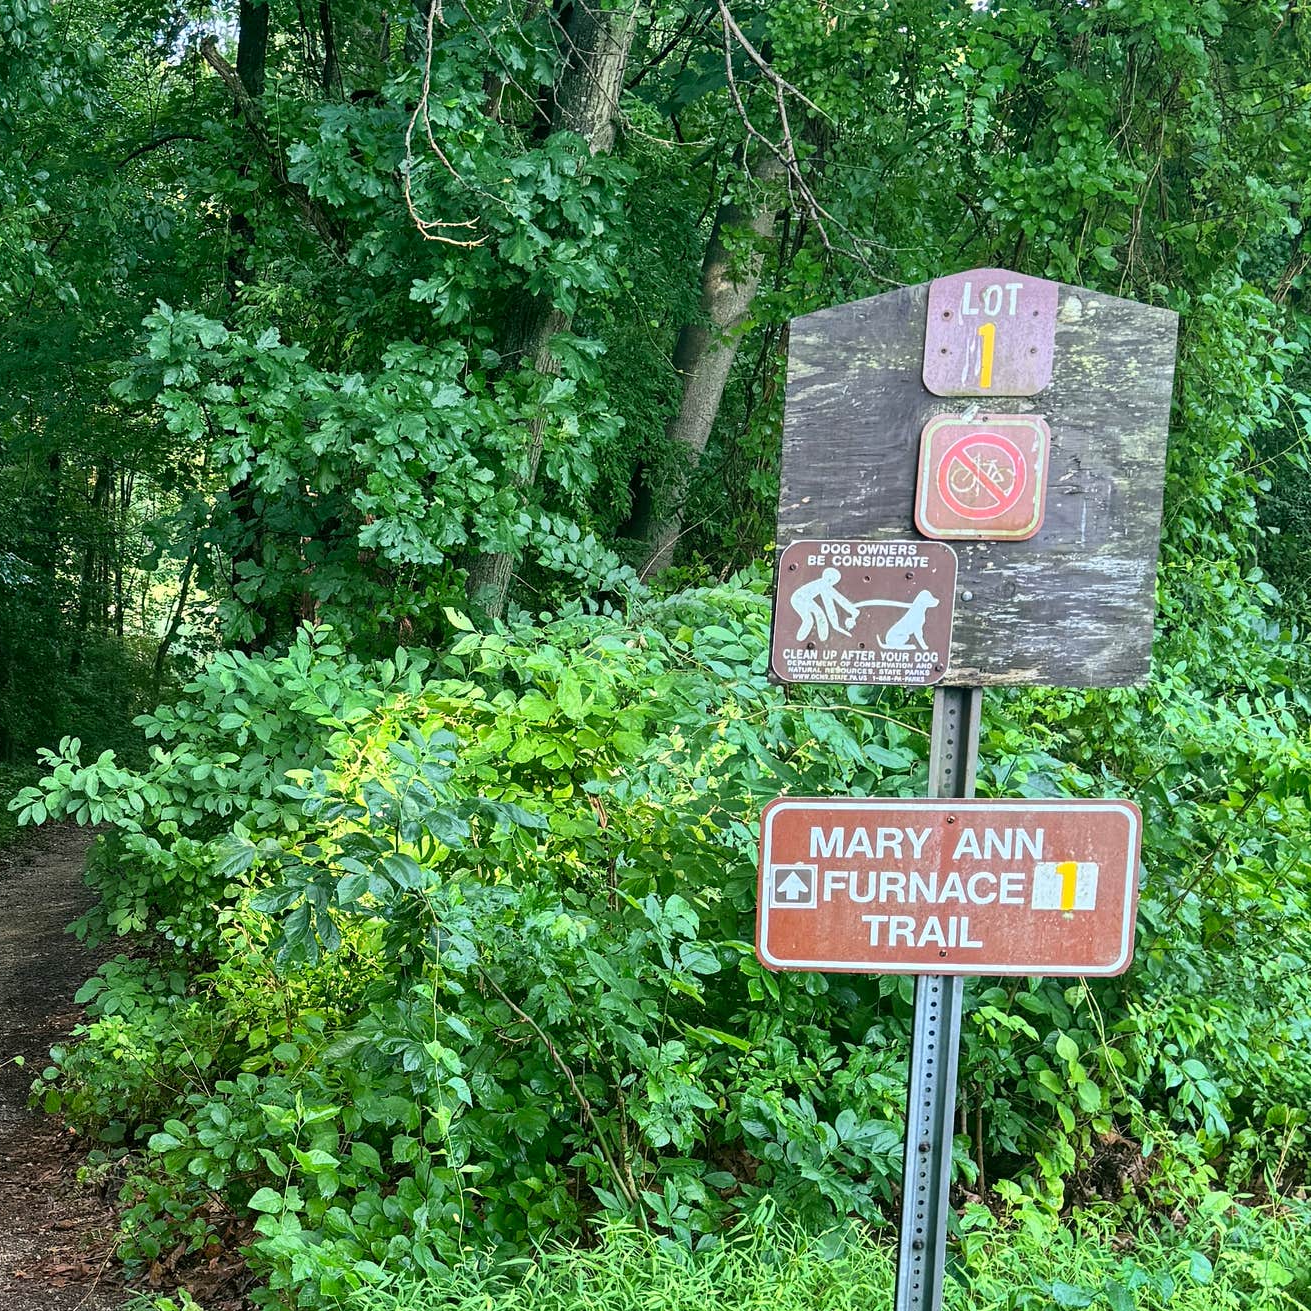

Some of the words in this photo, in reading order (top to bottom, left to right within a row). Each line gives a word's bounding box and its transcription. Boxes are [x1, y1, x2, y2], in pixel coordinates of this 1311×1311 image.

[962, 282, 1024, 316] LOT
[977, 322, 996, 388] 1
[807, 555, 826, 566] BE
[832, 556, 929, 568] CONSIDERATE
[820, 543, 851, 554] DOG
[857, 544, 917, 555] OWNERS
[782, 649, 818, 660] CLEAN
[822, 650, 837, 660] UP
[841, 650, 876, 661] AFTER
[880, 651, 910, 662] YOUR
[914, 652, 938, 663] DOG
[787, 660, 837, 668] DEPARTMENT
[853, 661, 914, 669] CONSERVATION
[788, 666, 822, 674] NATURAL
[879, 668, 903, 676] STATE
[809, 826, 933, 859] MARY
[953, 828, 1044, 860] ANN
[823, 870, 1026, 904] FURNACE
[1055, 861, 1078, 911] 1
[862, 915, 983, 948] TRAIL
